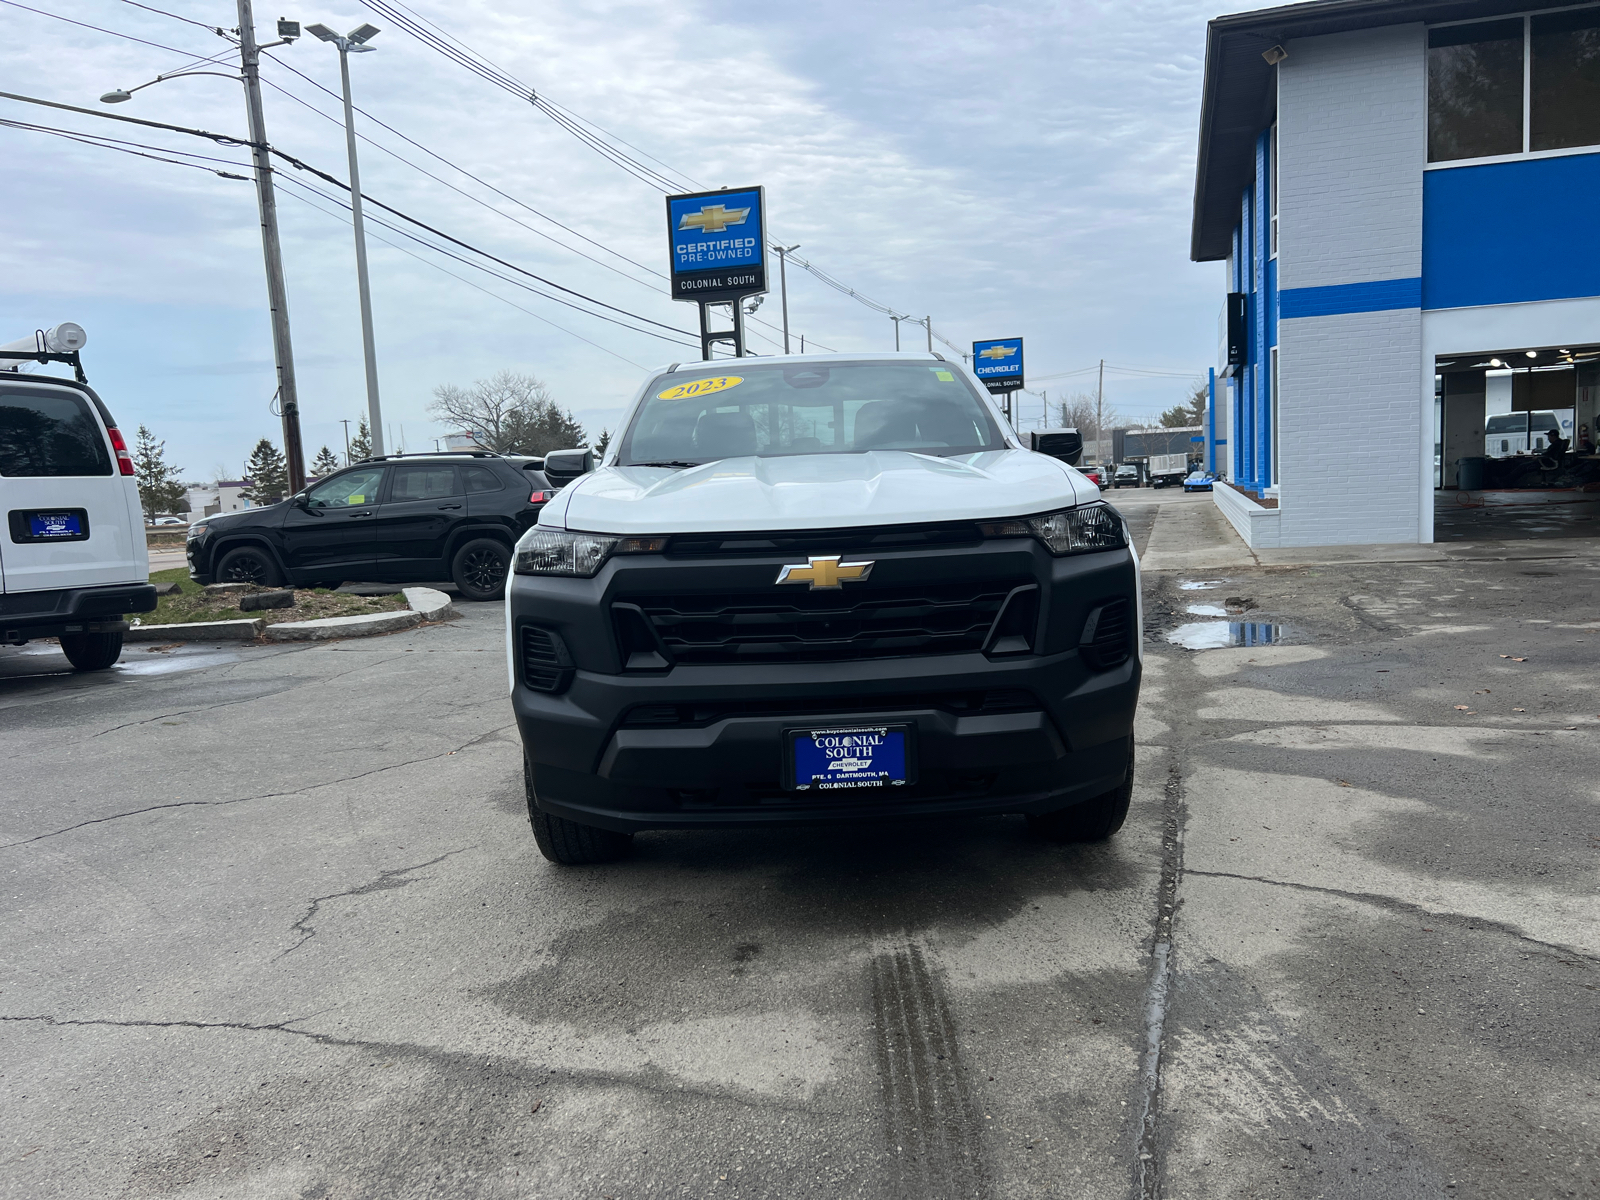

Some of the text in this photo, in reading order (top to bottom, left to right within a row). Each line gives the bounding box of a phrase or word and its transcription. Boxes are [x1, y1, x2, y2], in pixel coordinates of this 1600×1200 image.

[677, 238, 755, 254] CERTIFIED
[681, 248, 752, 263] PRE-OWNED
[681, 275, 755, 290] COLONIAL SOUTH
[977, 364, 1020, 374] CHEVROLET
[672, 377, 728, 398] 2023
[815, 735, 883, 748] COLONIAL
[826, 746, 872, 758] SOUTH
